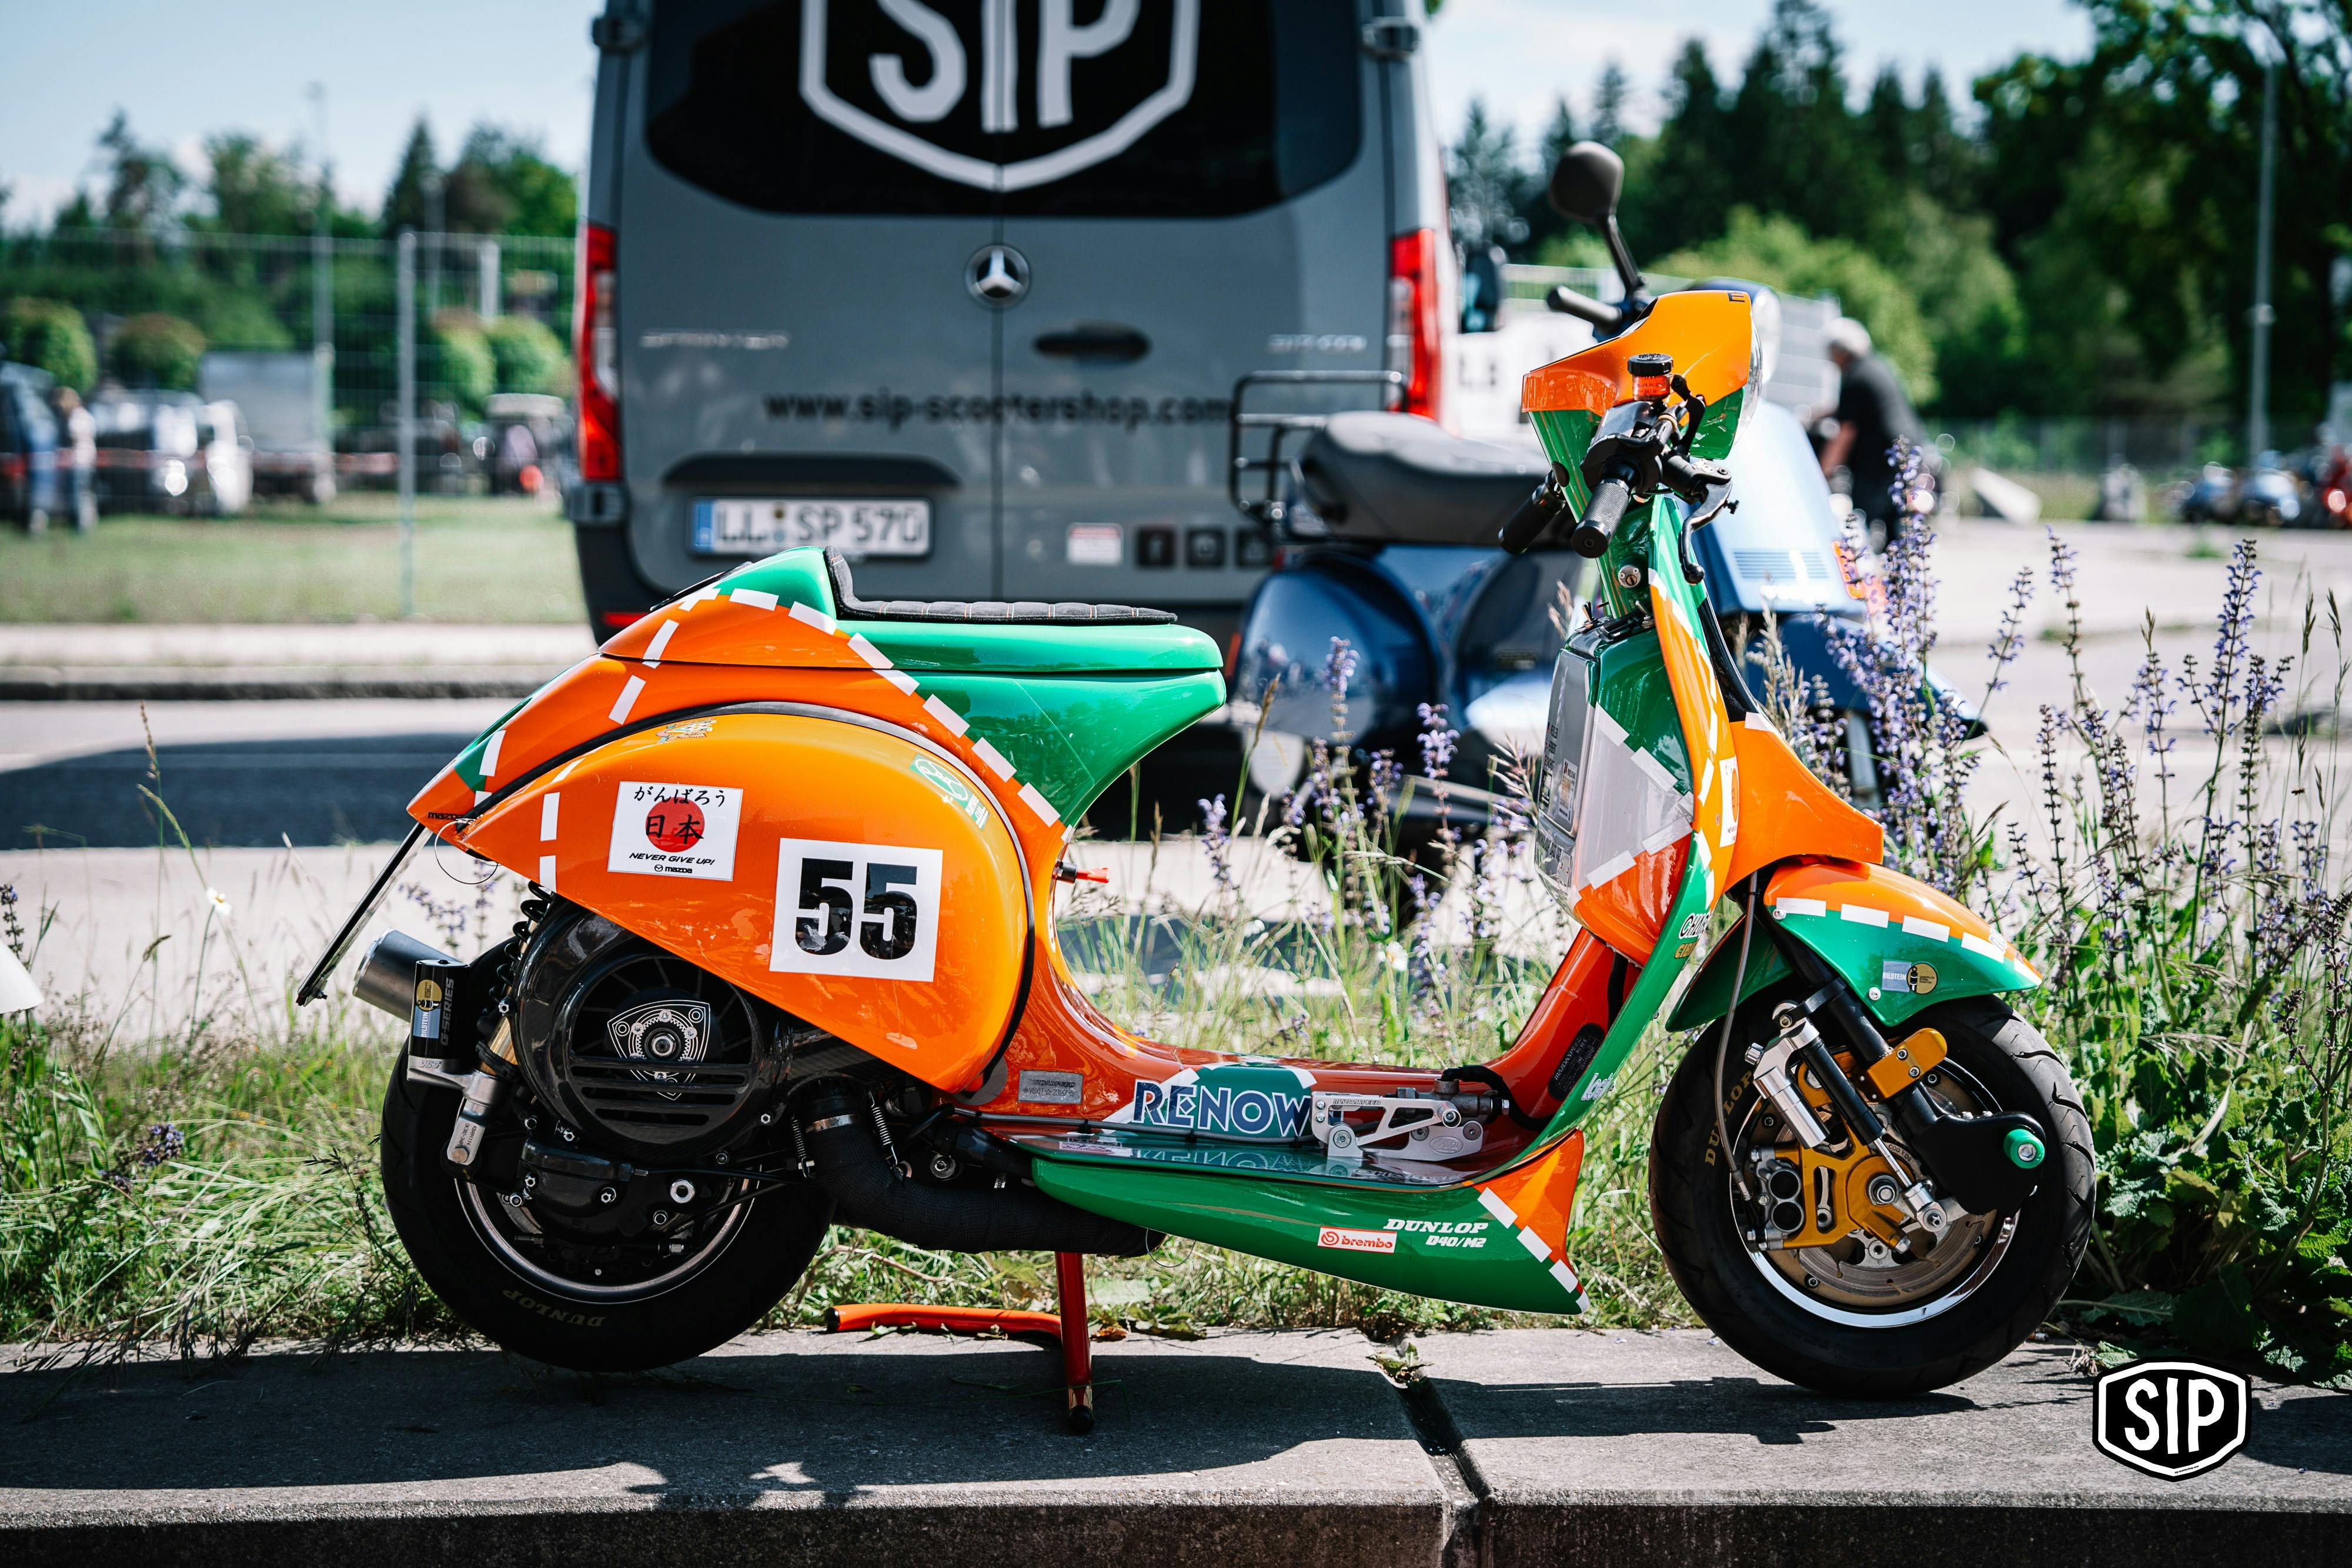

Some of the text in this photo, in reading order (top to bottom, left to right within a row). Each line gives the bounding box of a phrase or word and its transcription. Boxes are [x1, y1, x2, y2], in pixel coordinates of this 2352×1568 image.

[868, 0, 1141, 133] SIP
[715, 504, 926, 543] LL SP 570
[634, 786, 725, 807] がんばろう
[646, 814, 704, 845] 日本
[629, 852, 666, 862] NEVER
[668, 855, 695, 864] GIVE
[795, 857, 918, 960] 55
[1883, 972, 1906, 981] BILSTEIN
[421, 1011, 429, 1038] BILSTEIN
[441, 977, 455, 1047] G-SERIES
[1132, 1079, 1344, 1138] RENOW
[1705, 1070, 1752, 1166] DULOP
[1383, 1218, 1489, 1233] DUNLOP
[1341, 1235, 1393, 1249] brembo
[1425, 1235, 1486, 1248] D40/M2
[502, 1289, 606, 1327] DUNLOP
